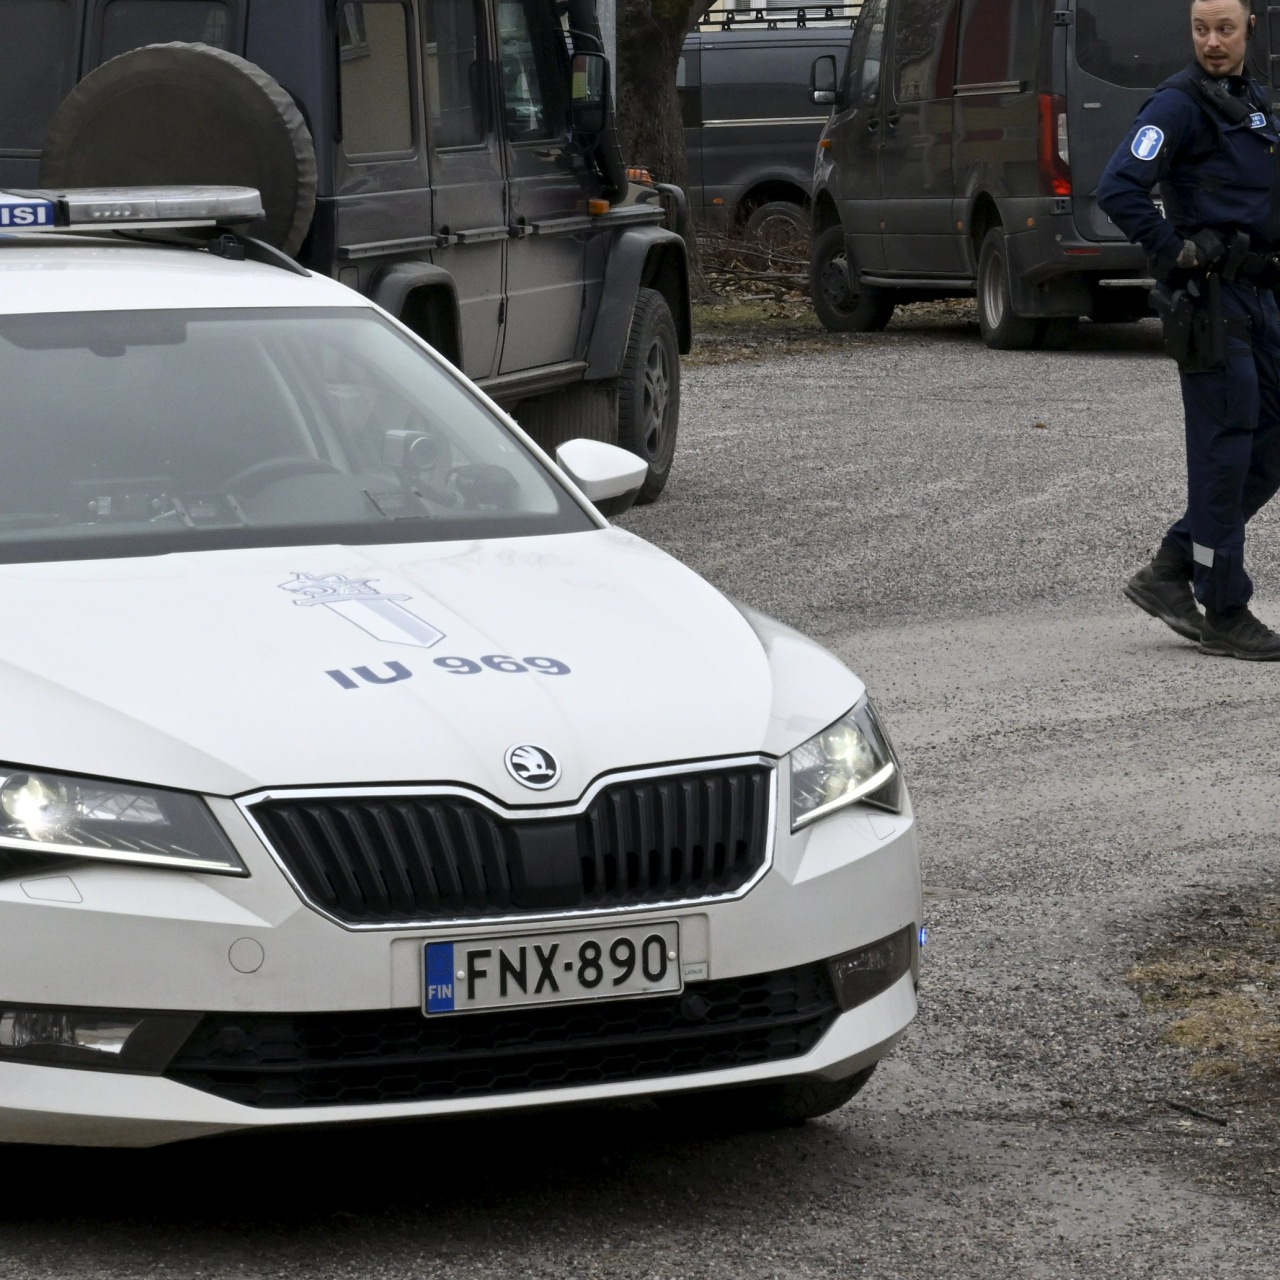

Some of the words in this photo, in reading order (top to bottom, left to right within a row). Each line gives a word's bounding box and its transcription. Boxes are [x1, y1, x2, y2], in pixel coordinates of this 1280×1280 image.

[324, 660, 413, 690] IU
[433, 654, 572, 676] 969
[428, 983, 452, 1000] FIN
[467, 933, 667, 1000] FNX-890
